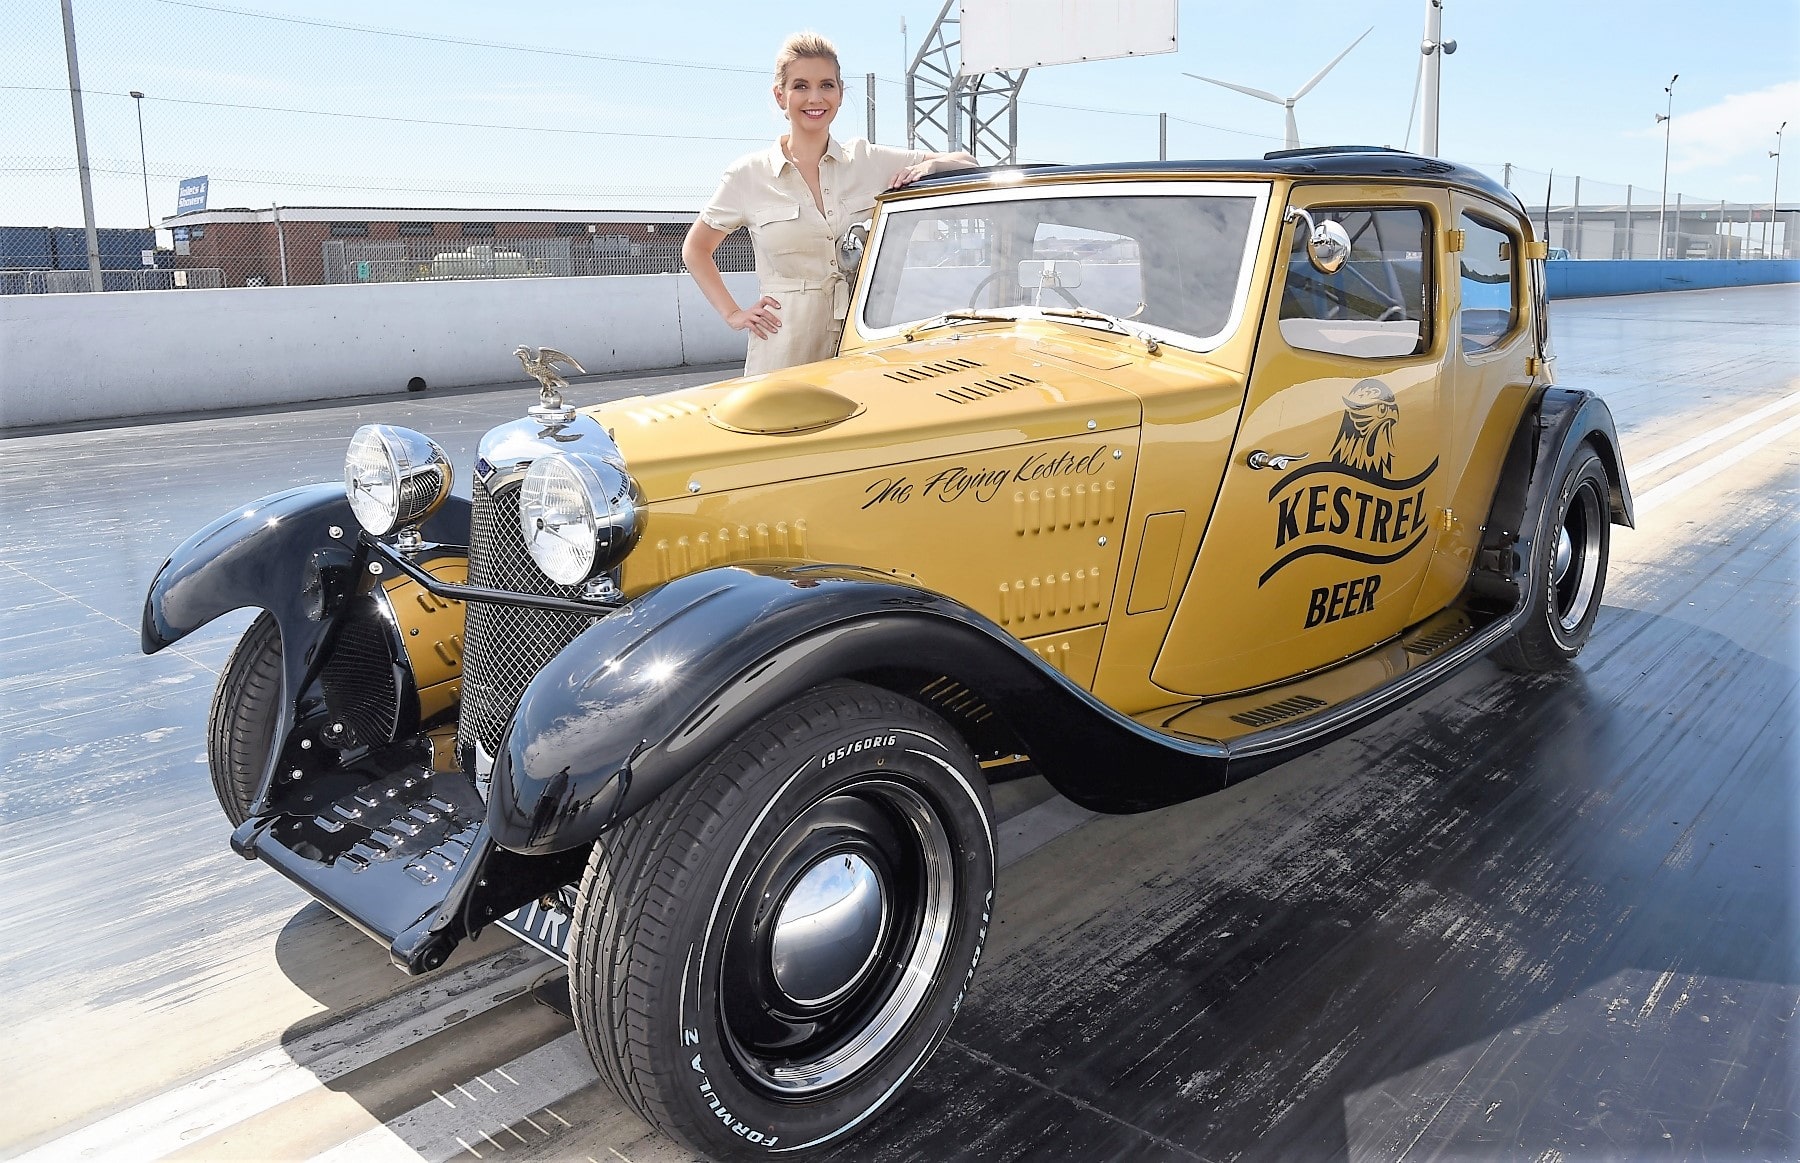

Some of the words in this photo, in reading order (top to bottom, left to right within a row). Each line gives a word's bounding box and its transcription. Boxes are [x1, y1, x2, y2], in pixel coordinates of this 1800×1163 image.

[861, 476, 914, 510] The
[922, 466, 1011, 503] Flying
[1012, 445, 1107, 482] Kestrel
[1275, 485, 1426, 550] KESTREL
[1546, 505, 1564, 615] FORMULA
[1303, 574, 1381, 629] BEER
[821, 735, 897, 769] 195/60R16
[952, 889, 993, 1014] VITOUR
[683, 1028, 700, 1047] Z
[690, 1053, 779, 1148] FORMULA
